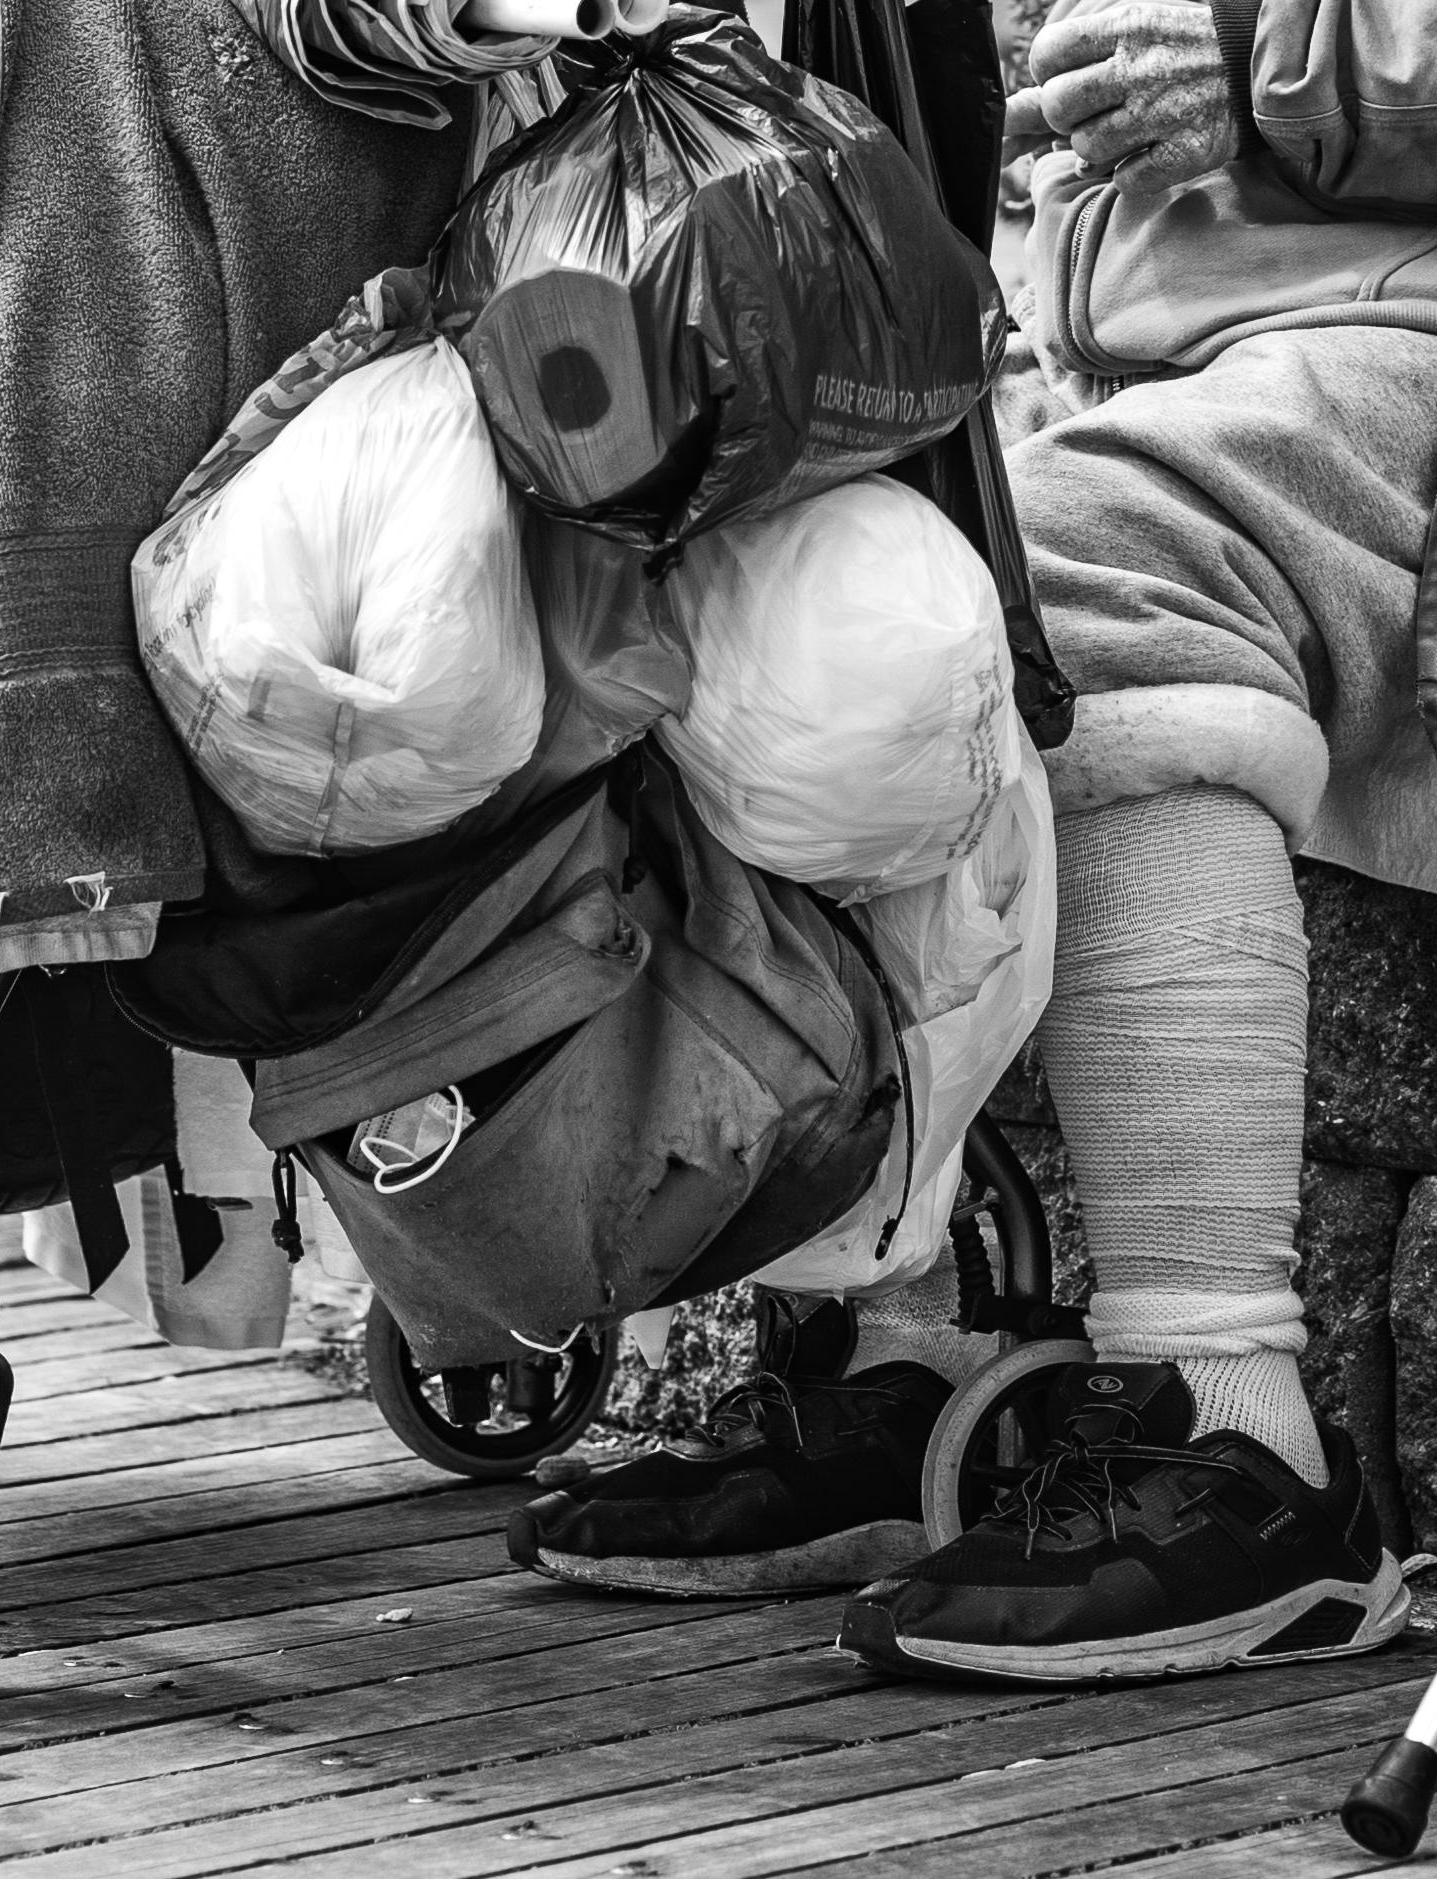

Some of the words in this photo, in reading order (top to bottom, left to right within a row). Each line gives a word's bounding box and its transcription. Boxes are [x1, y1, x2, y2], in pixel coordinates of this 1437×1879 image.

[814, 374, 856, 414] PLEASE
[856, 380, 897, 422] RETURN
[899, 389, 914, 424] TO
